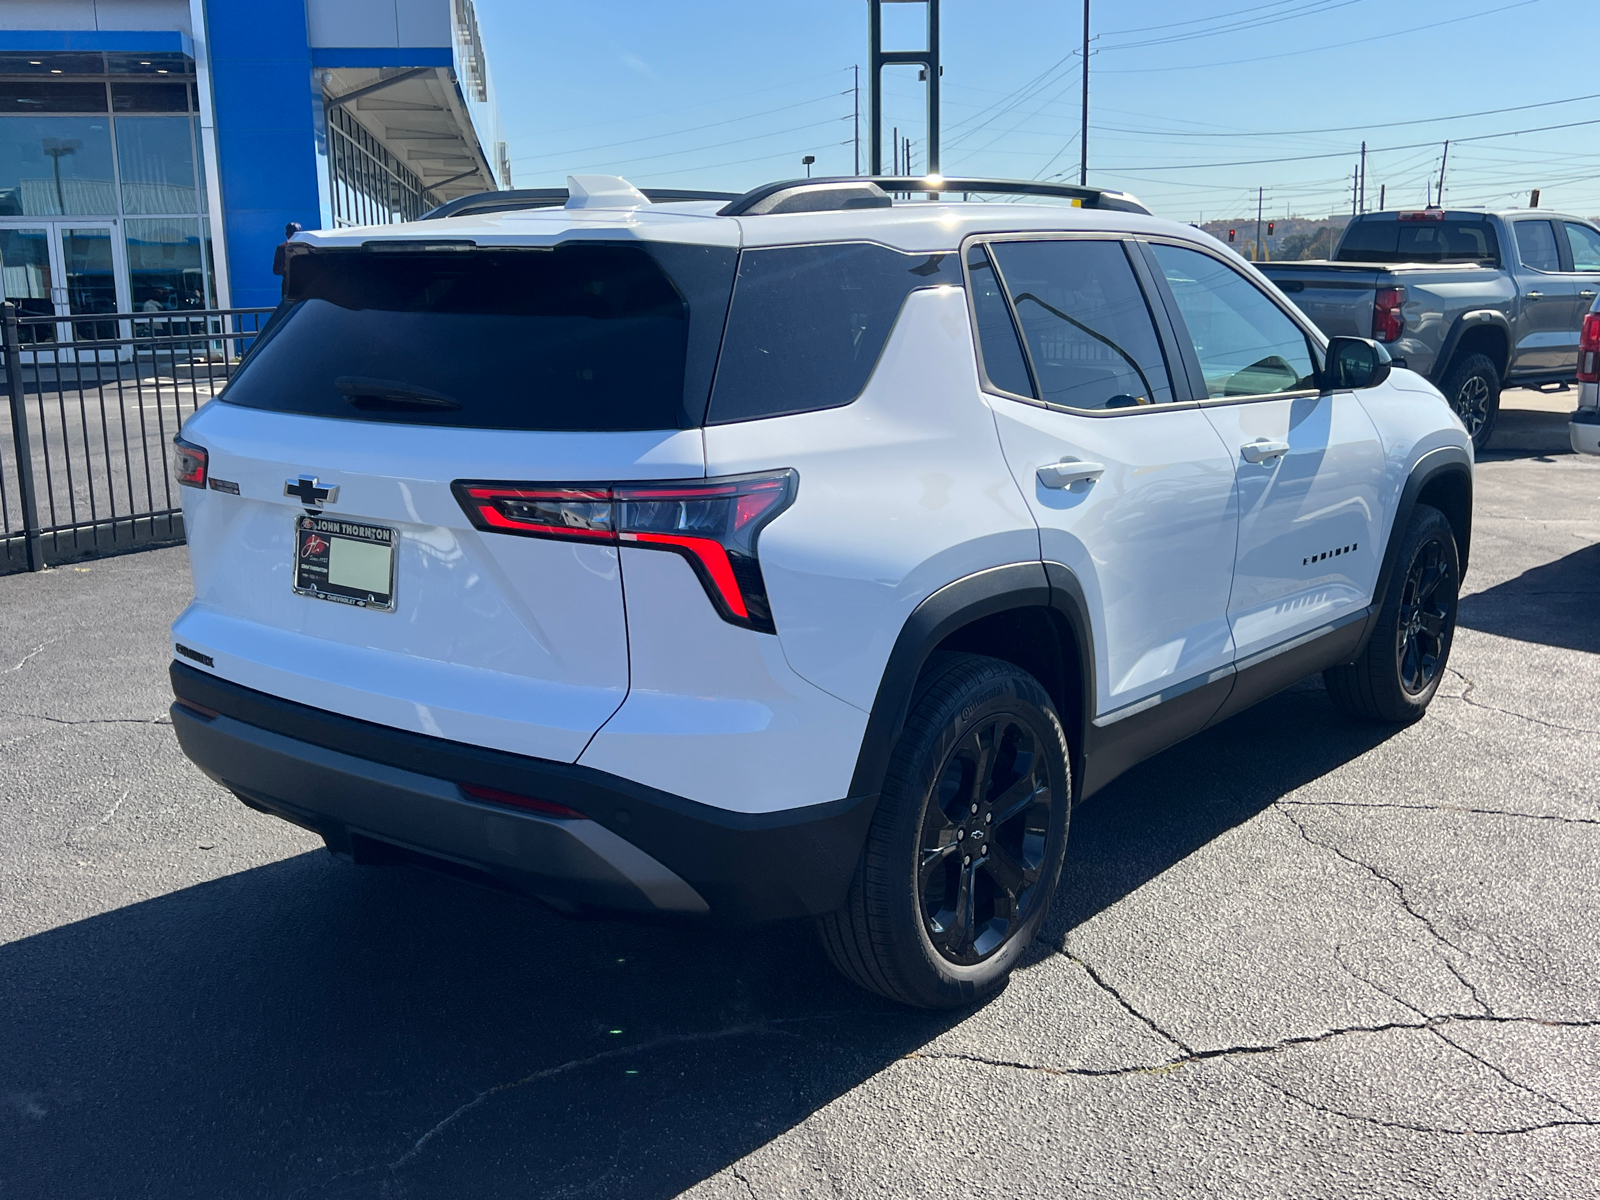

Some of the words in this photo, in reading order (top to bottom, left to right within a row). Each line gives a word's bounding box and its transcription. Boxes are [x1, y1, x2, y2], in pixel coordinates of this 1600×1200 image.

[317, 520, 340, 532] JOHN
[326, 594, 356, 605] CHEVROLET
[960, 683, 1005, 722] Continental
